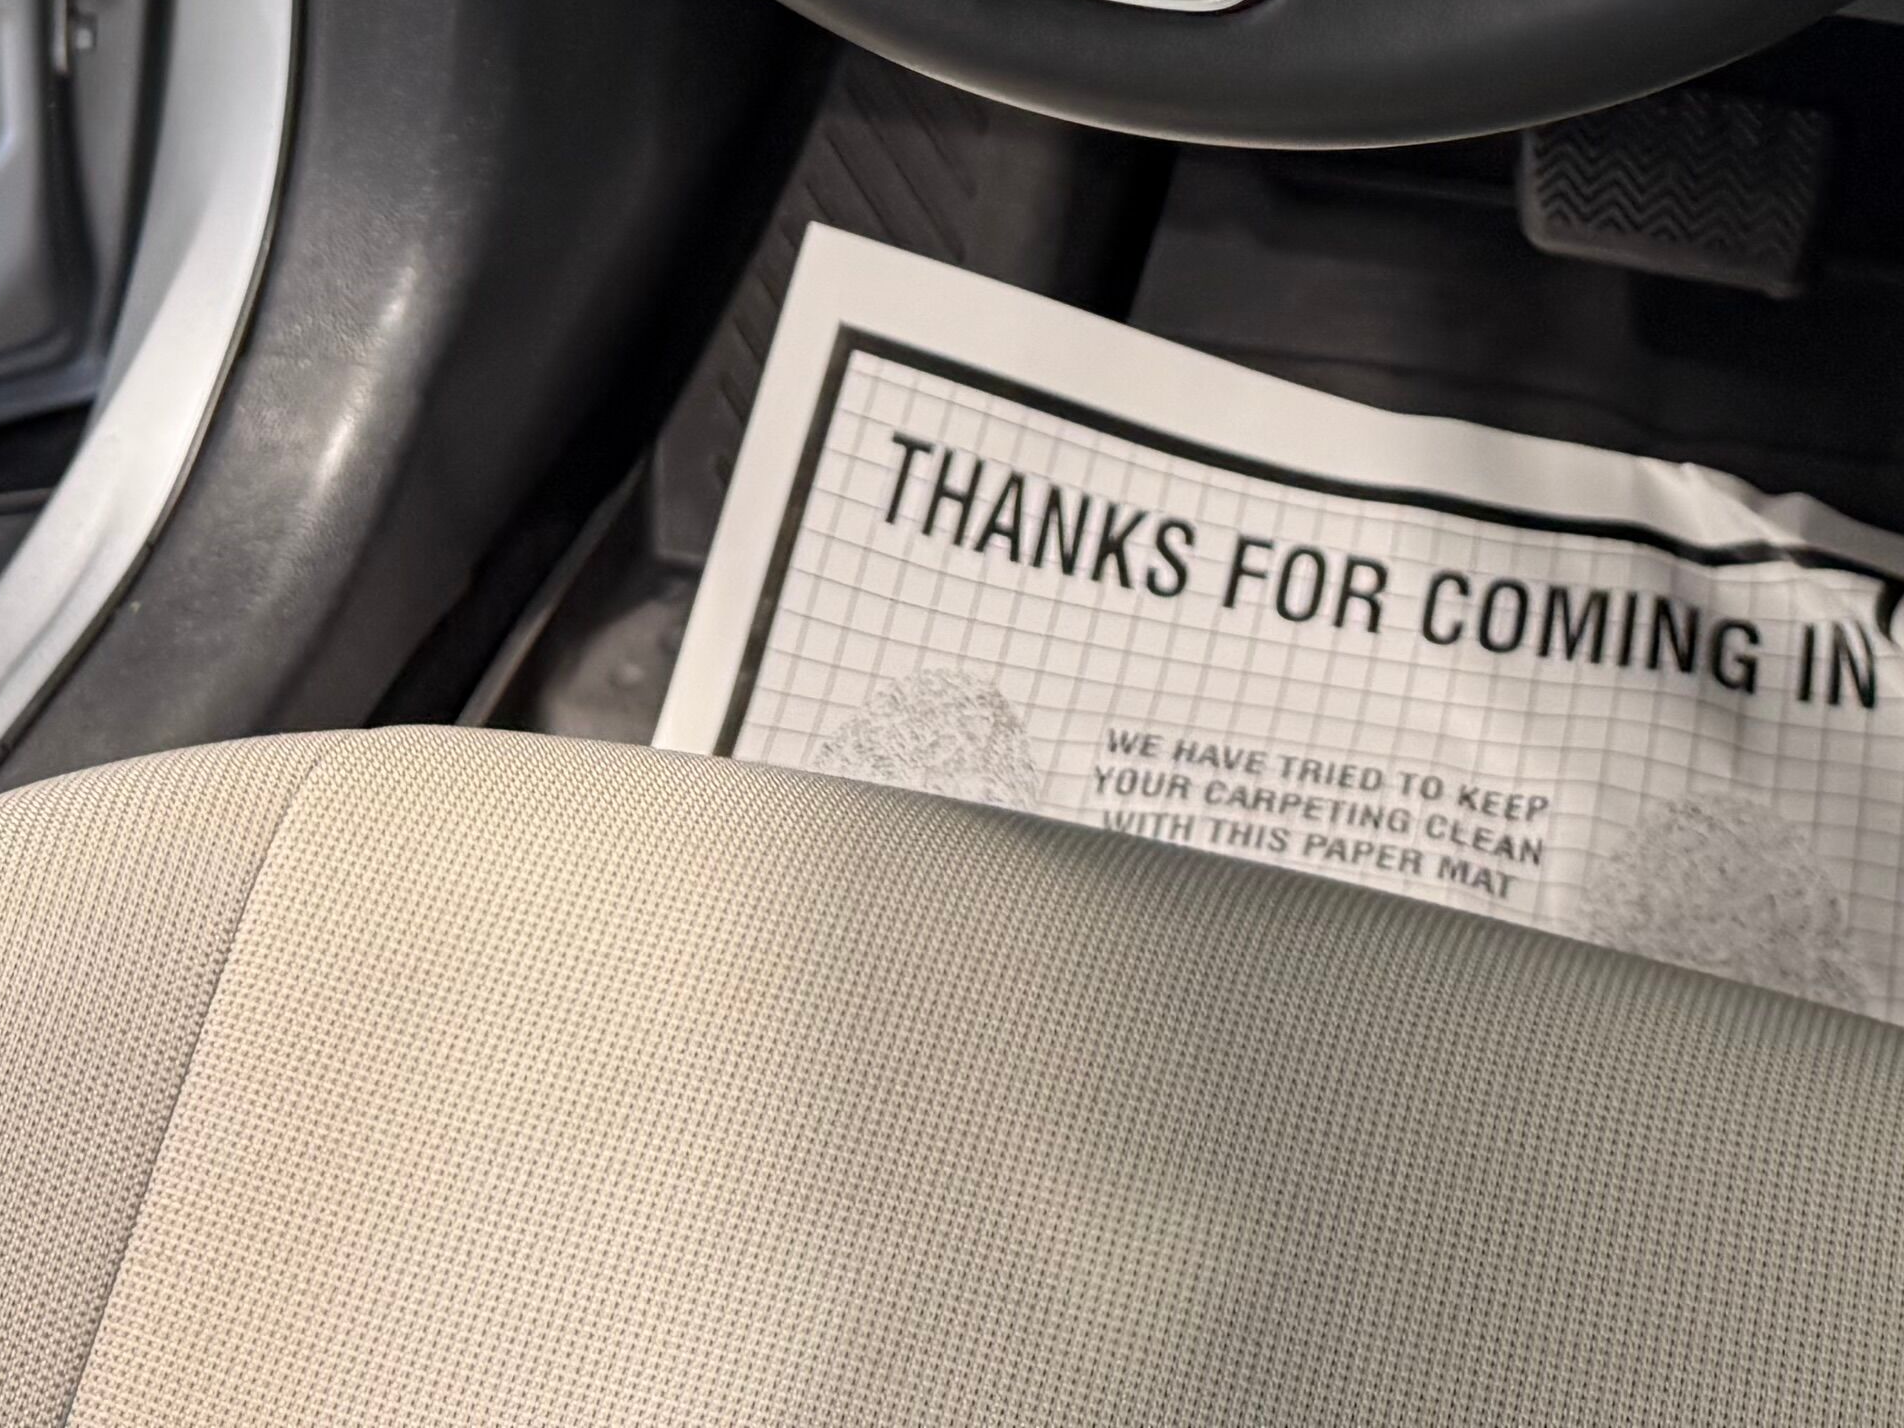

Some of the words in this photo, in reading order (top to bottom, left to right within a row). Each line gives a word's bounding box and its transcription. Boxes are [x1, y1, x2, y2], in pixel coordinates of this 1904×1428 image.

[884, 429, 1197, 598] THANKS
[1222, 532, 1389, 635] FOR
[1420, 568, 1762, 696] COMING
[1796, 619, 1877, 710] IN
[1093, 764, 1191, 801] YOUR
[1203, 778, 1412, 837] CARPETING
[1425, 813, 1544, 867] CLEAN
[1106, 727, 1163, 759] WE
[1172, 738, 1267, 778] HAVE
[1278, 754, 1384, 794] TRIED
[1399, 771, 1444, 802] TO
[1456, 784, 1549, 824] KEEP
[1103, 809, 1196, 842] WITH
[1207, 815, 1291, 856] THIS
[1302, 832, 1423, 877] PAPER
[1437, 853, 1523, 901] MAT
